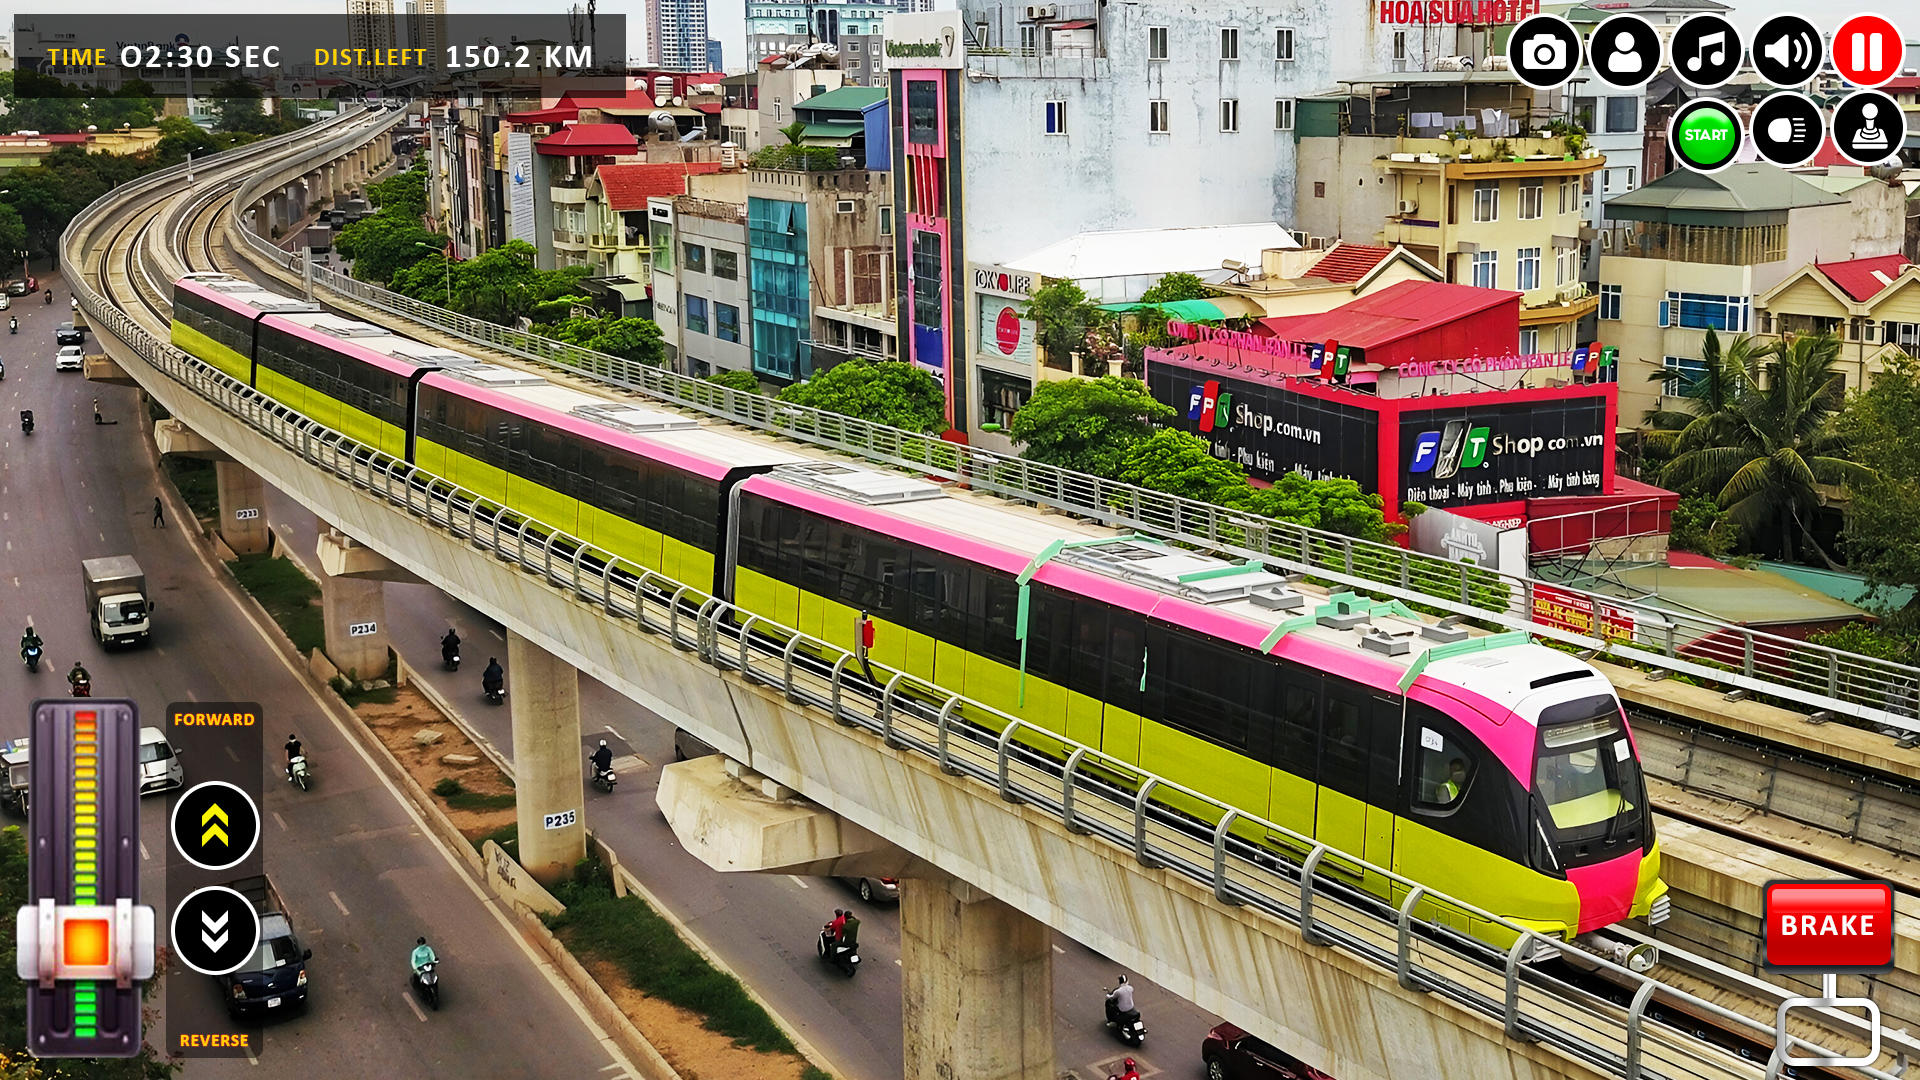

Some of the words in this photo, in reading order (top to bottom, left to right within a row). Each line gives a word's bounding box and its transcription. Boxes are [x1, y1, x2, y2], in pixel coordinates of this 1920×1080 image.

[1380, 1, 1424, 23] HOA
[1309, 348, 1350, 371] FPT
[1412, 432, 1489, 468] FT
[546, 811, 575, 827] P235
